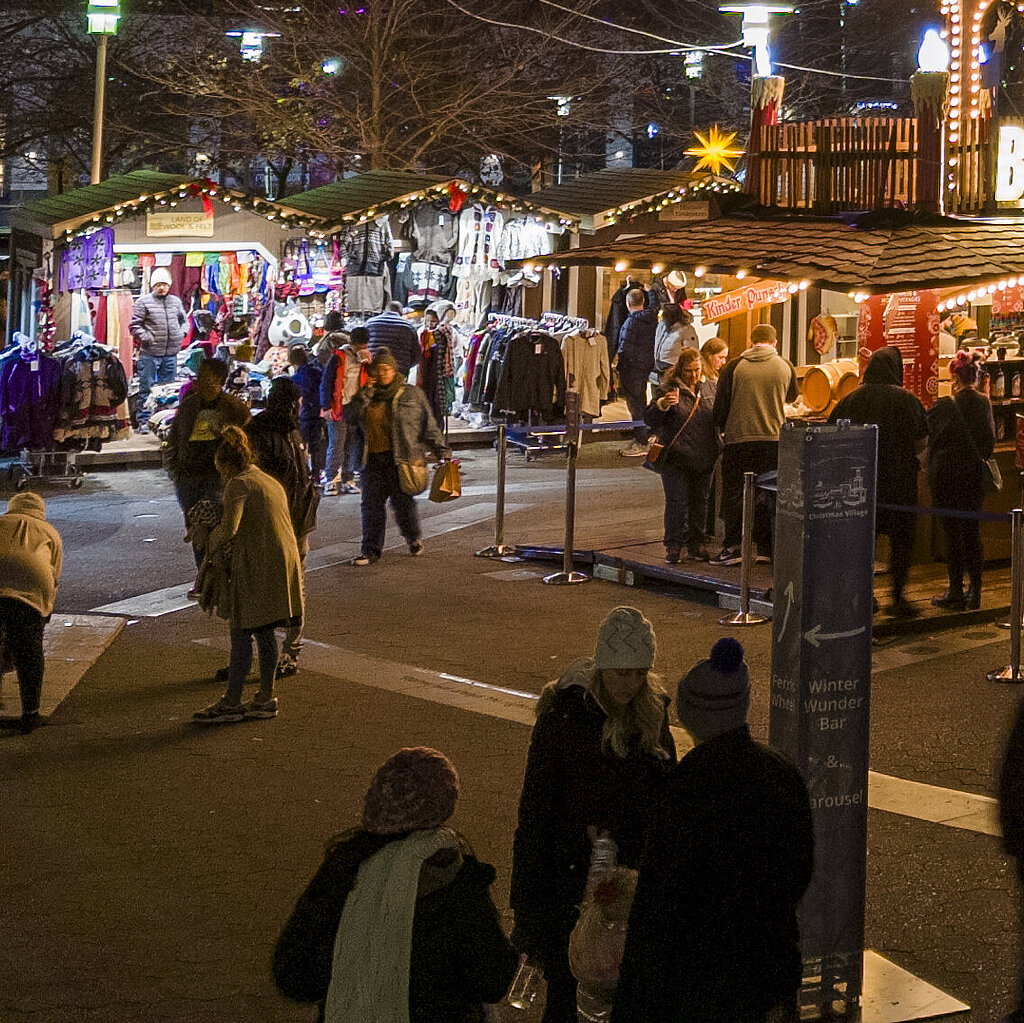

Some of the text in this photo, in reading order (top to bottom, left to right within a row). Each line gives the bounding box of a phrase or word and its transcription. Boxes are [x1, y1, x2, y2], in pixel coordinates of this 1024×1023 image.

[705, 295, 742, 320] Kinder
[808, 511, 844, 521] Christmas
[845, 509, 868, 519] Village
[808, 678, 860, 694] Winter
[804, 696, 864, 714] Wunder
[819, 717, 847, 732] Bar
[808, 789, 864, 810] arousel
